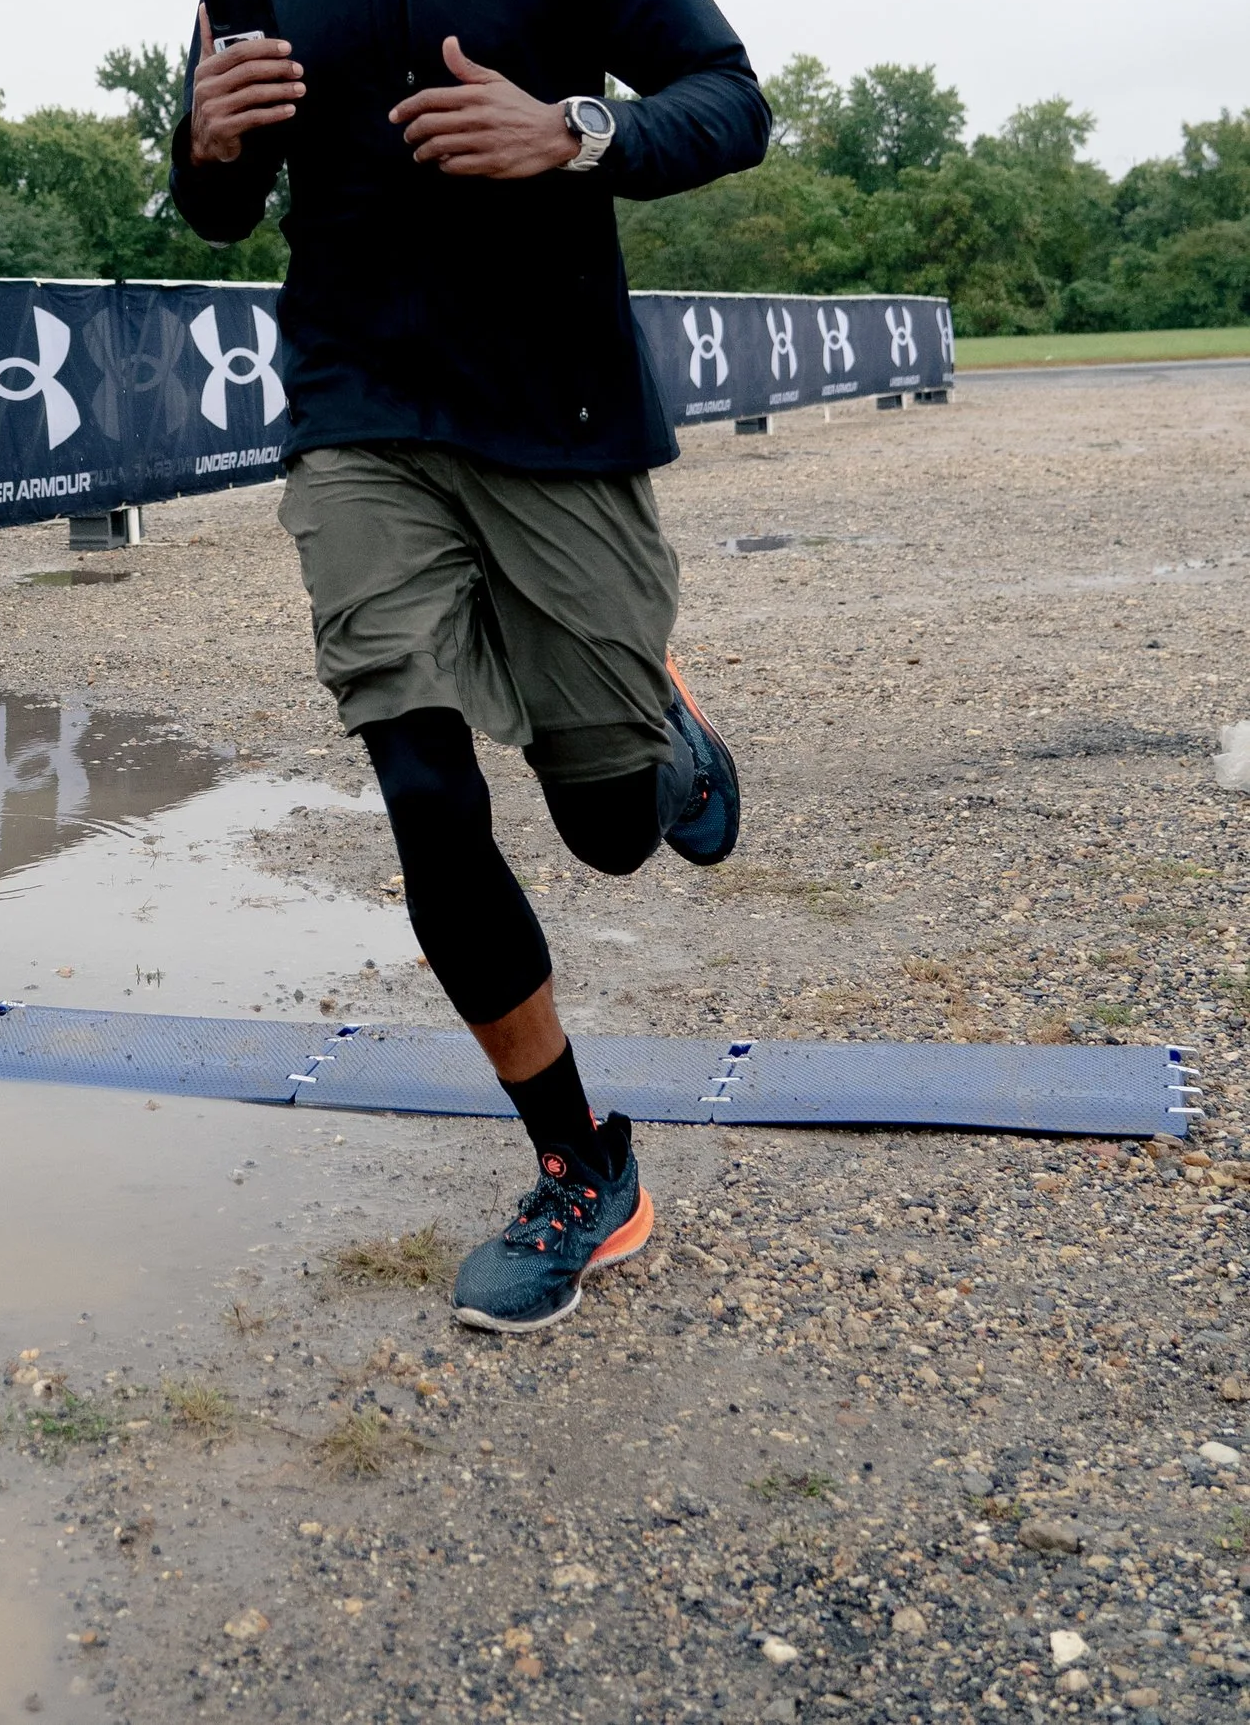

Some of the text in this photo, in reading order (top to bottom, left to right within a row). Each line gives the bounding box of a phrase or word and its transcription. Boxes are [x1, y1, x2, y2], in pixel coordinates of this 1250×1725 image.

[196, 451, 238, 475] UNDER
[237, 445, 281, 468] ARMOU
[16, 472, 91, 501] ARMOUR
